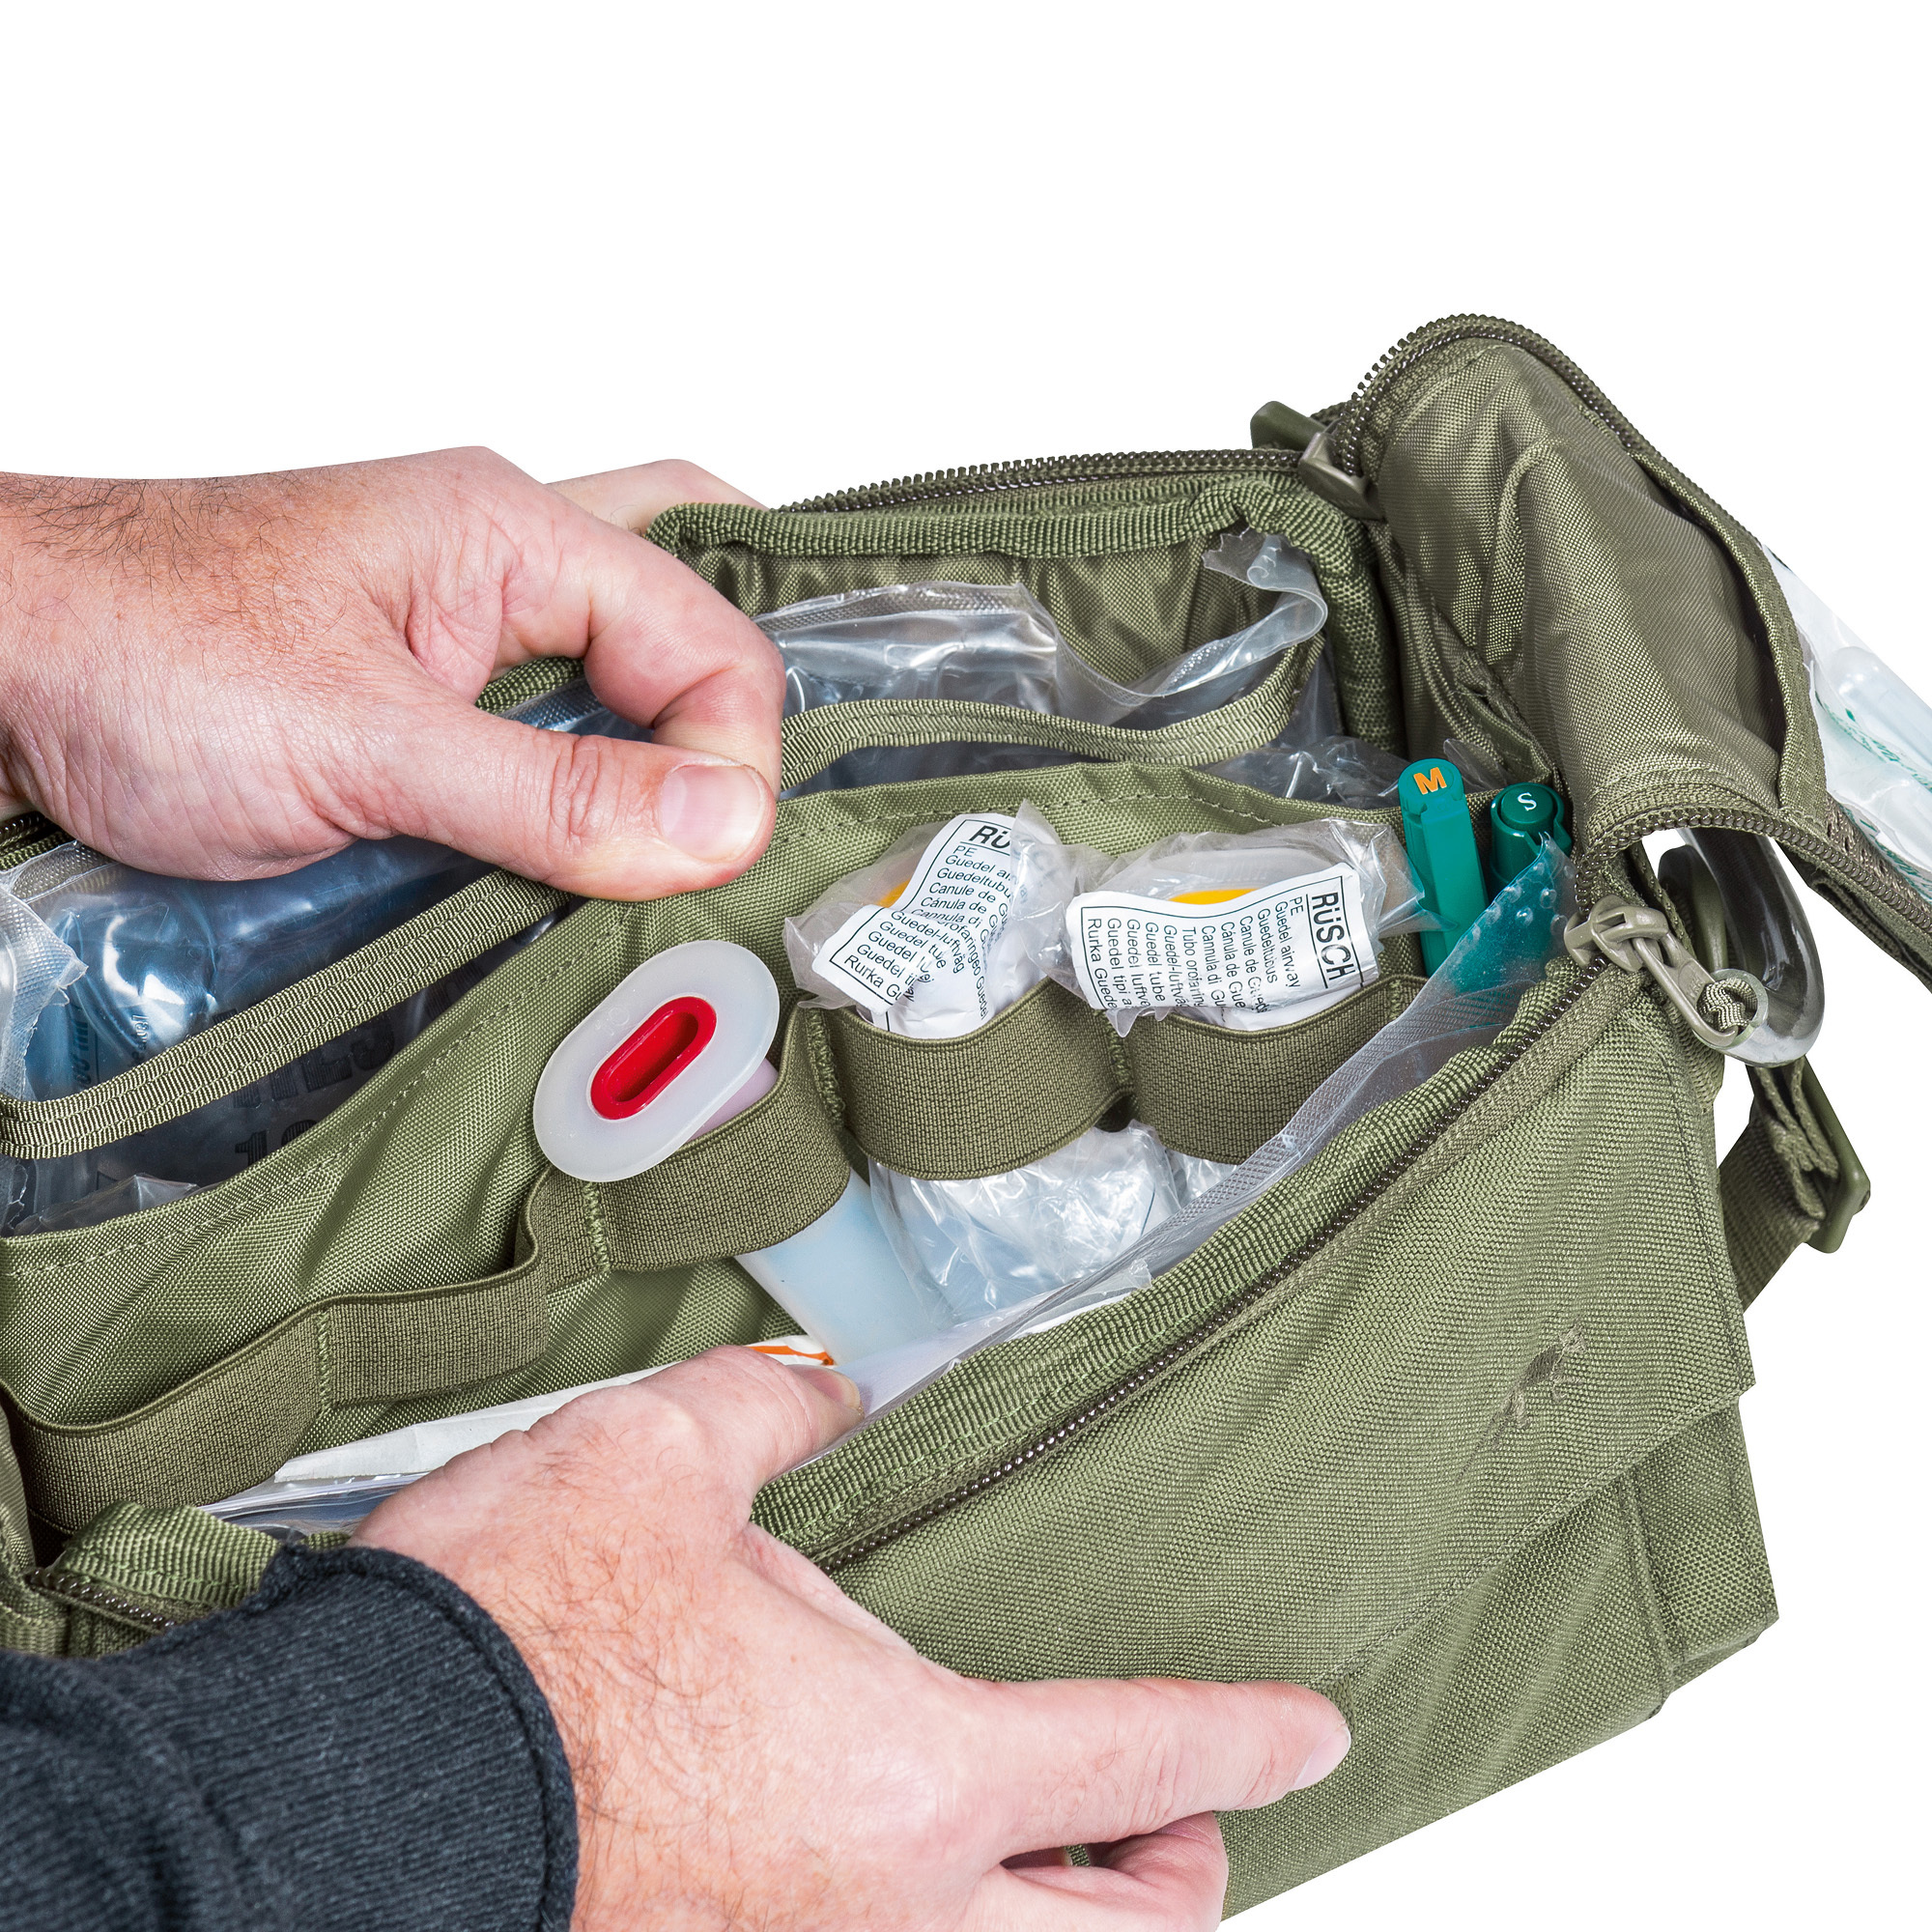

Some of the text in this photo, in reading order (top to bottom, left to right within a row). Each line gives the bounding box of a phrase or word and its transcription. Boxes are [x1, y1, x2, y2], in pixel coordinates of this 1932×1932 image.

[1413, 767, 1447, 795] M
[1517, 792, 1538, 811] S
[946, 855, 996, 873] Guedel
[953, 845, 978, 857] PE
[929, 882, 996, 903] Canule de
[937, 867, 1012, 902] Guedeltubu
[921, 896, 987, 914] Cánula de
[1289, 896, 1304, 916] PE
[880, 921, 928, 949] Guedel
[968, 917, 983, 928] di
[1239, 915, 1258, 956] Canule
[868, 931, 918, 962] Guedel
[1108, 918, 1125, 970] Guedel
[1126, 919, 1144, 968] Guedel
[1182, 926, 1198, 955] Tubo
[1201, 925, 1220, 972] Cannula
[1220, 922, 1238, 961] Cánula
[1257, 908, 1278, 983] Guedeltubus
[1274, 900, 1301, 988] Guedel airway
[843, 954, 885, 988] Rurka
[857, 944, 906, 979] Guedel
[1087, 918, 1118, 1009] Rurka Guede
[1146, 922, 1166, 1002] Guedel tube
[1226, 963, 1240, 978] de
[1244, 958, 1260, 974] de
[1113, 975, 1131, 994] tipi
[1207, 974, 1223, 984] di
